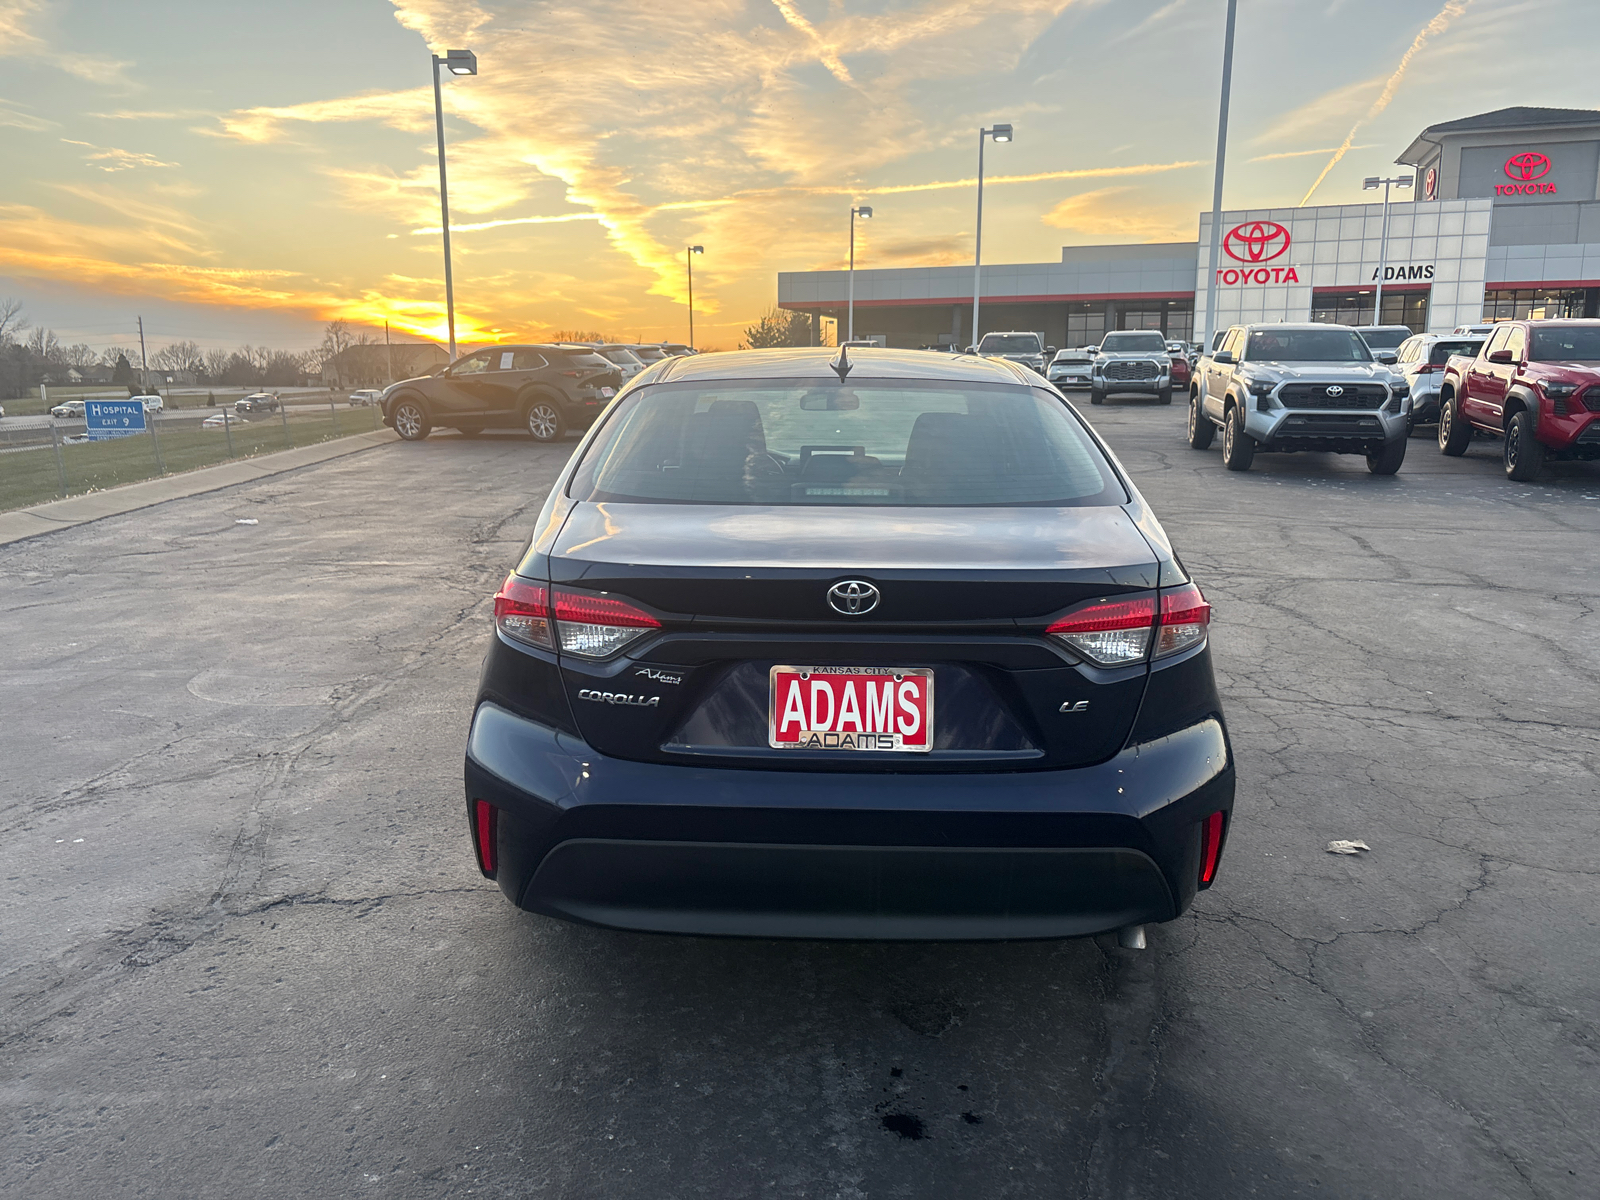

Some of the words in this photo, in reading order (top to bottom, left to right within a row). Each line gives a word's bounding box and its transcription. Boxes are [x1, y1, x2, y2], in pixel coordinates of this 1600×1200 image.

[1494, 182, 1557, 196] TOYOTA
[1371, 265, 1434, 281] ADAMS
[91, 404, 139, 416] HOSPITAL
[122, 417, 130, 427] 9
[635, 668, 682, 682] Adams
[813, 666, 860, 675] KANSAS
[864, 667, 891, 675] CITY
[578, 688, 660, 707] COROLLA
[780, 679, 921, 736] ADAMS
[1059, 700, 1089, 712] LE
[806, 733, 894, 749] ADAMS
